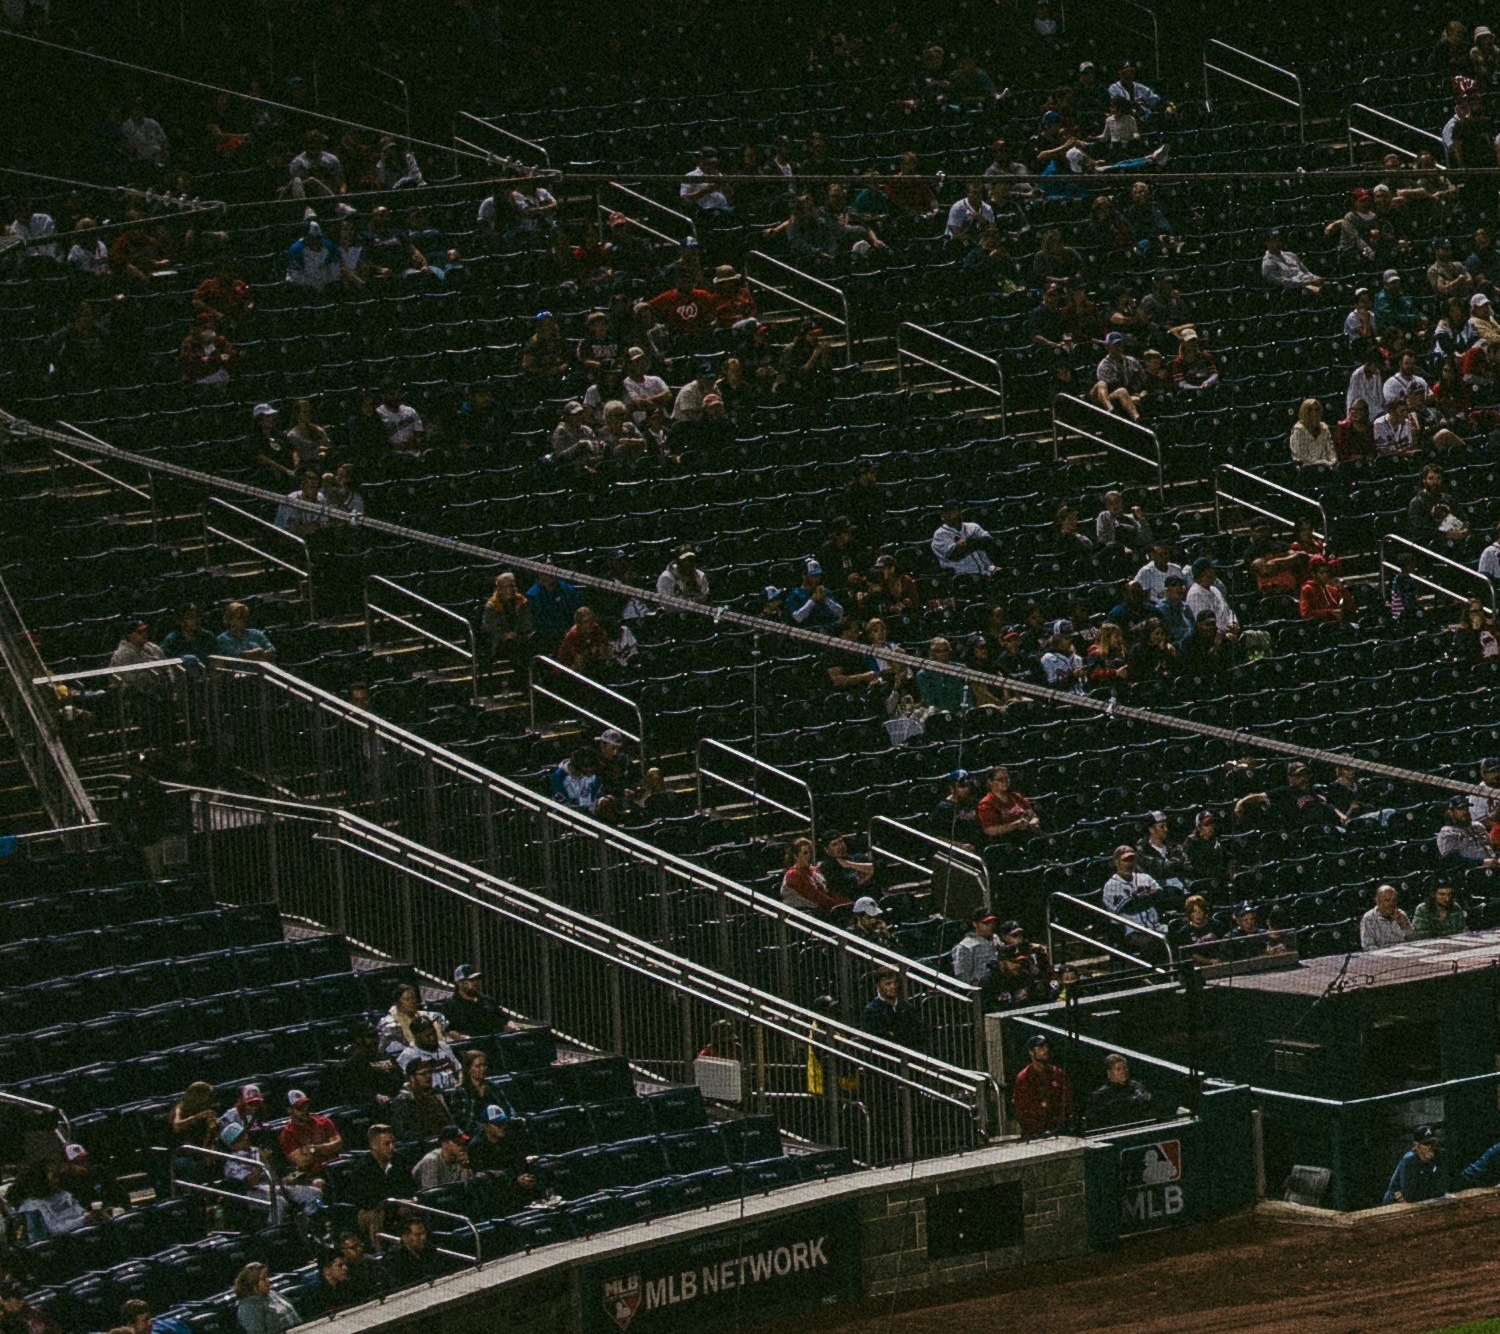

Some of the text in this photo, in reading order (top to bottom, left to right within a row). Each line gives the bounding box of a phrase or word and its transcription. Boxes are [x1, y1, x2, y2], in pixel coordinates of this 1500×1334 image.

[1121, 1184, 1185, 1224] MLB
[645, 1270, 698, 1311] MLB
[702, 1235, 830, 1296] NETWORK
